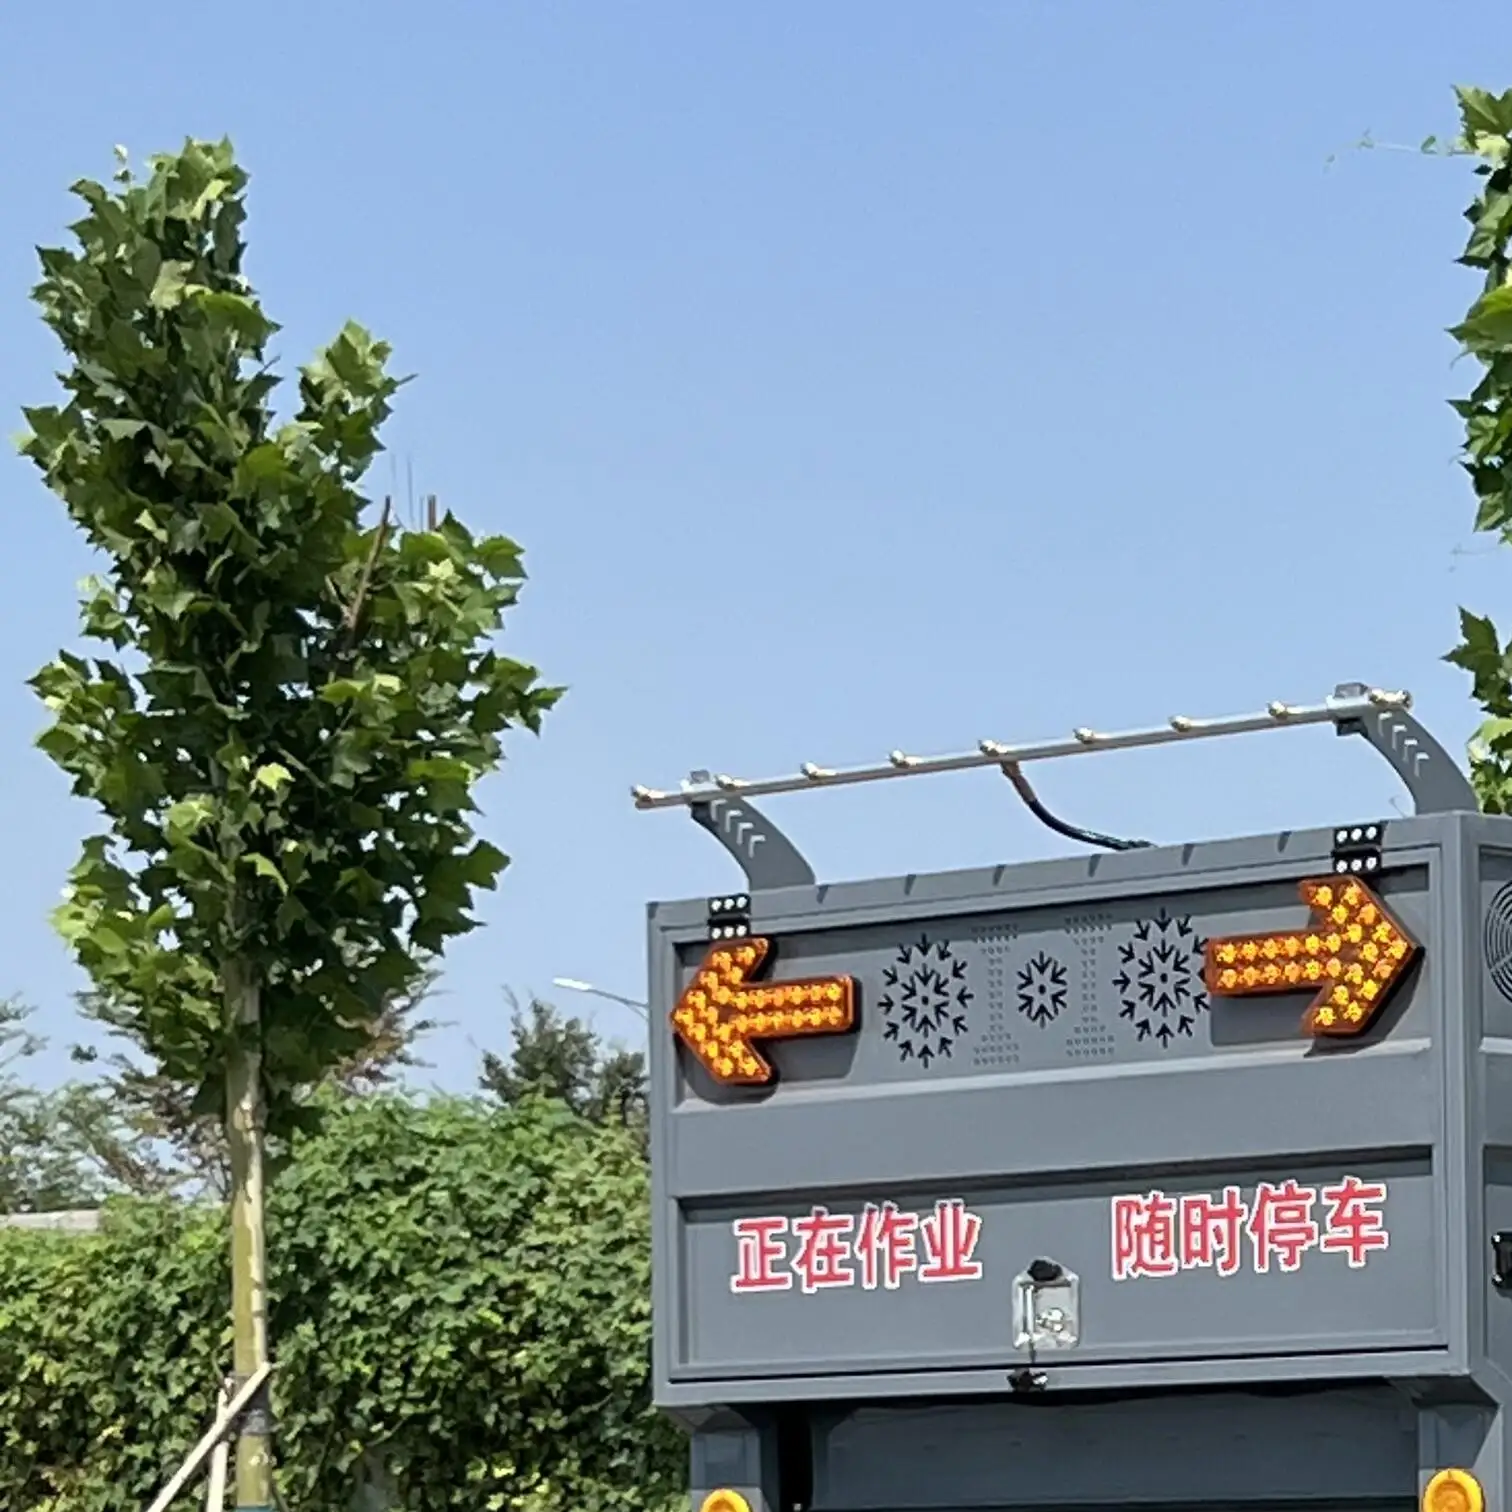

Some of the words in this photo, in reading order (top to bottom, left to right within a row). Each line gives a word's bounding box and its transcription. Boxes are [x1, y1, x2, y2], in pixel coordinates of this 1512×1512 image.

[731, 1199, 983, 1294] 正在作业
[1112, 1176, 1389, 1281] 随时停车
